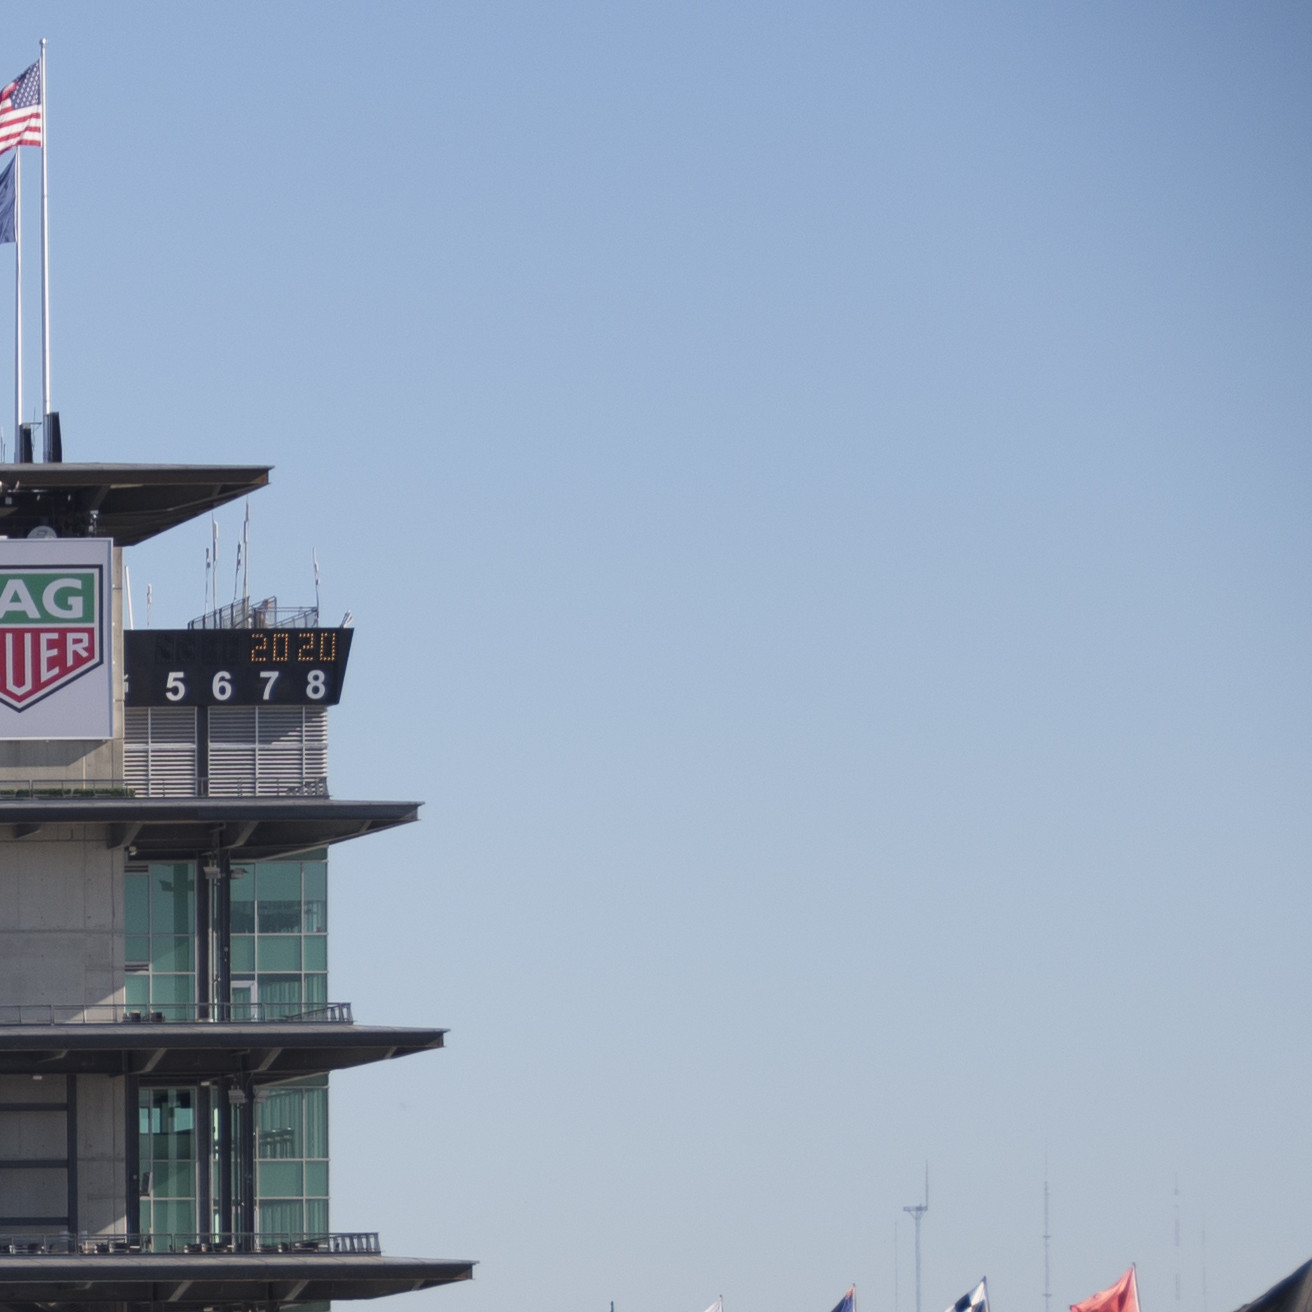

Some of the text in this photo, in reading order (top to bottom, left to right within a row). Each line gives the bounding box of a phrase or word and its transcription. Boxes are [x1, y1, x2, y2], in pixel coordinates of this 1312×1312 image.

[165, 672, 185, 702] 5
[212, 671, 232, 701] 6
[260, 671, 280, 701] 7
[306, 670, 326, 700] 8
